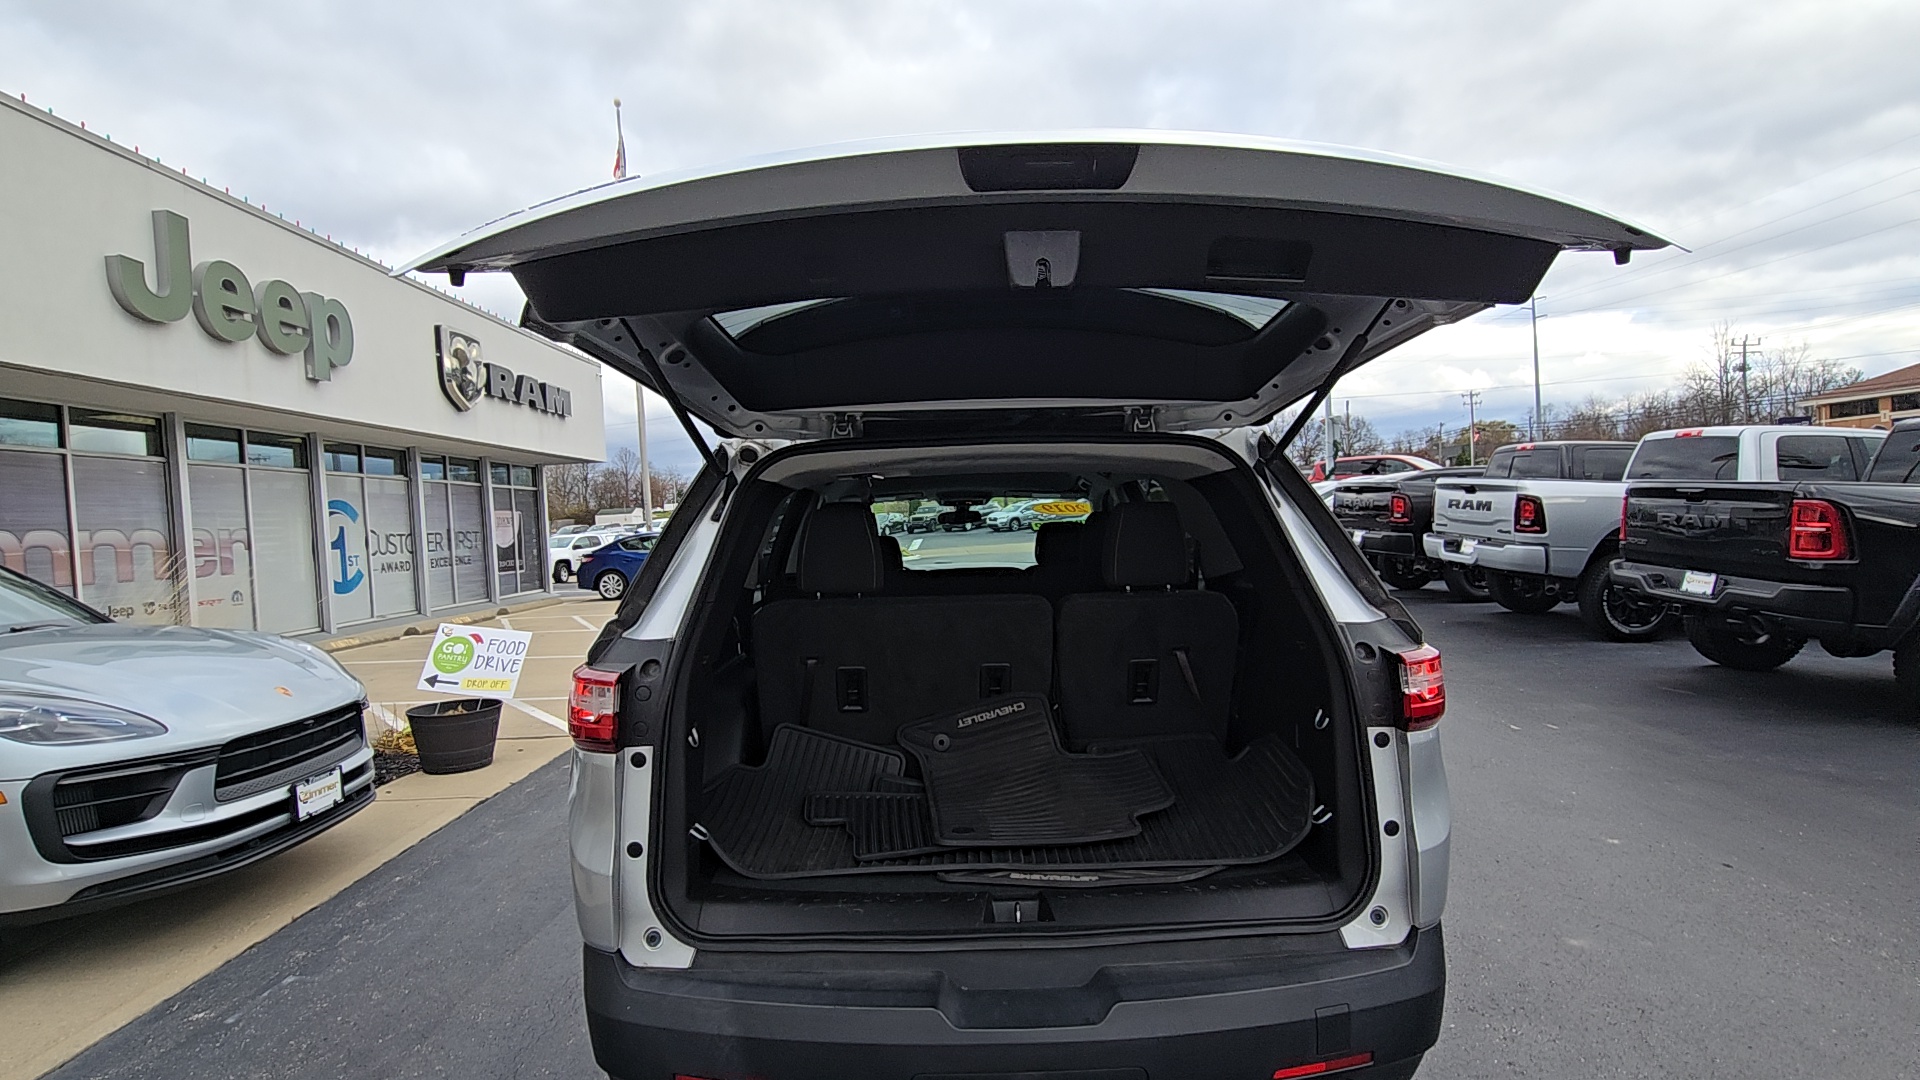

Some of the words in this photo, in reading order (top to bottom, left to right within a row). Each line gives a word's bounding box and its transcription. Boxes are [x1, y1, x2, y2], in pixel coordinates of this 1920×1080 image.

[104, 209, 354, 382] Jeep
[483, 362, 573, 416] RAM
[1343, 498, 1374, 508] RAM
[1447, 499, 1492, 511] RAM
[1656, 512, 1730, 529] RAM
[381, 560, 411, 573] AWARD
[104, 606, 134, 620] Jeep
[442, 642, 469, 655] GO!
[486, 639, 526, 655] FOOD
[474, 655, 521, 673] DRIVE
[466, 679, 488, 688] DROP
[490, 680, 508, 688] OFF
[957, 702, 1026, 728] CHEVROLET
